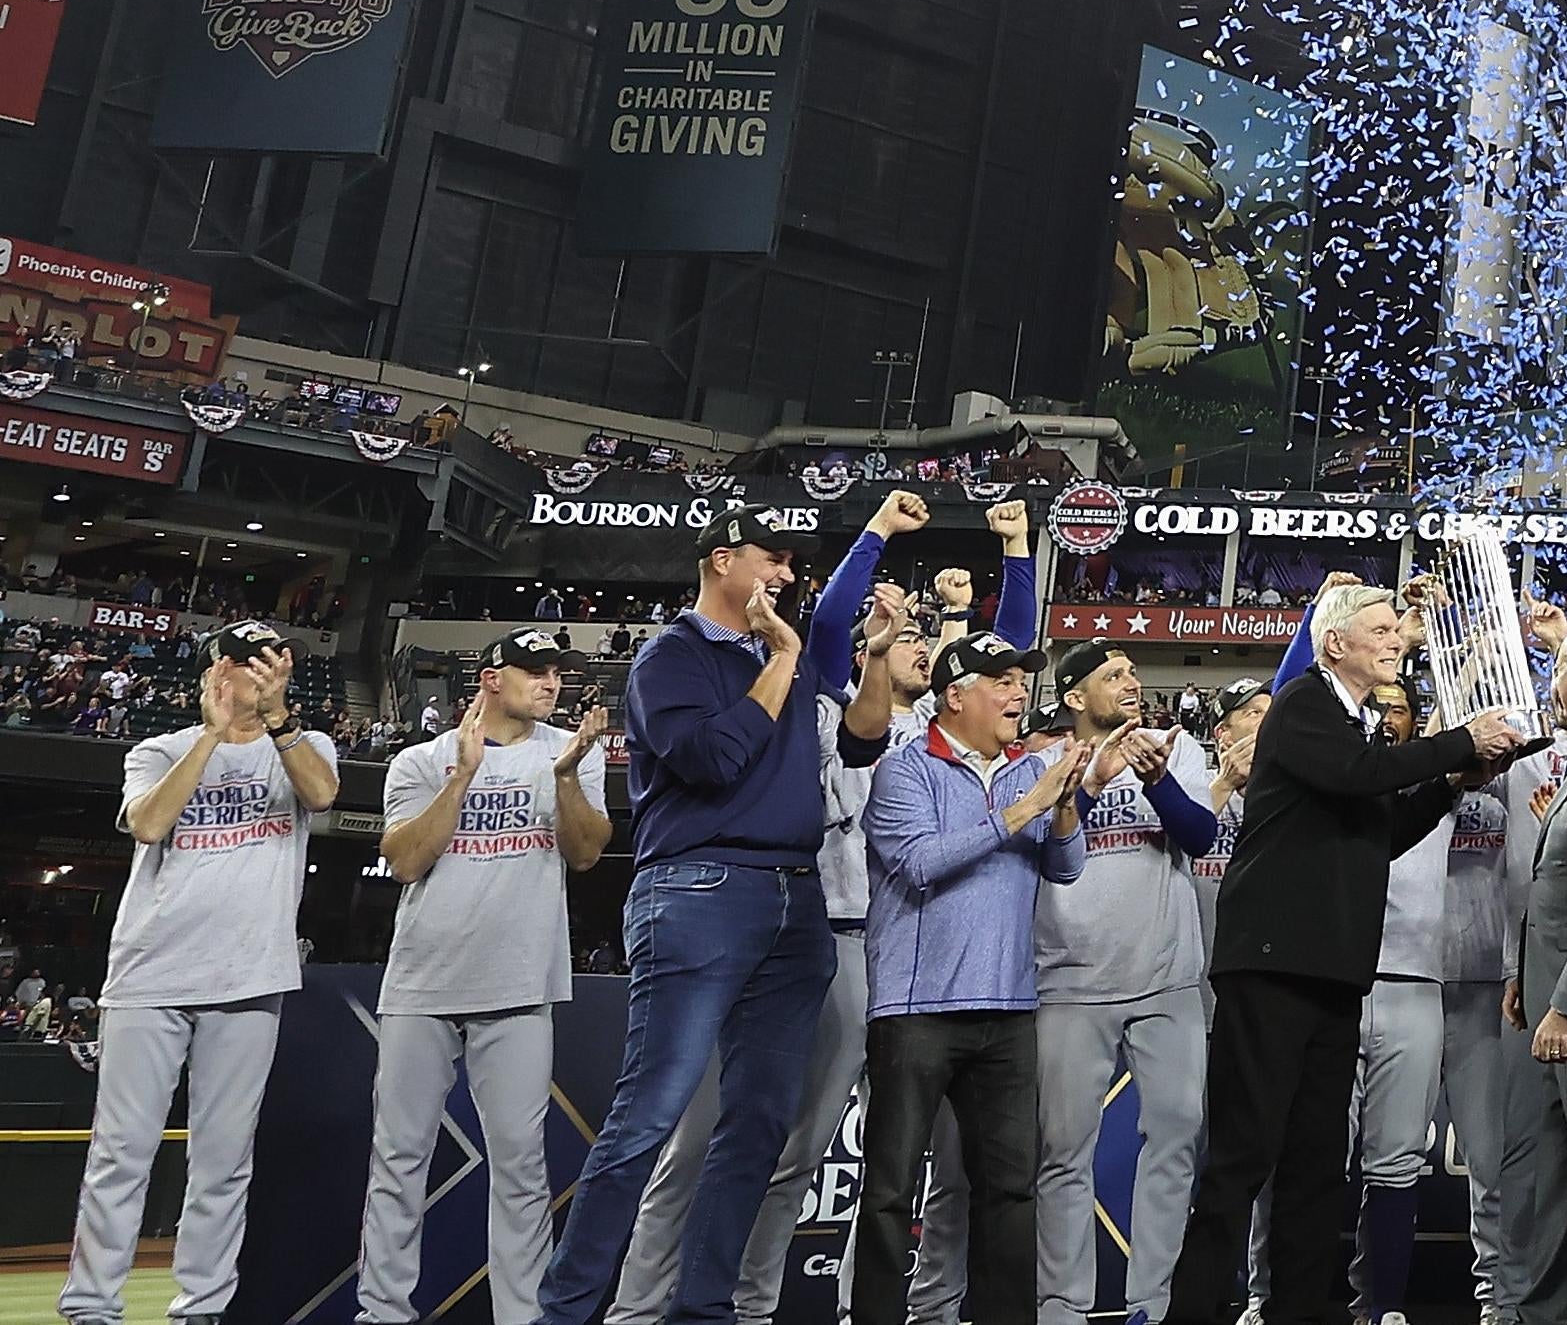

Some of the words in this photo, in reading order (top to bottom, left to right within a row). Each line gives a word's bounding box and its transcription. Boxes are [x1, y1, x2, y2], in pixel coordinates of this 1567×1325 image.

[214, 5, 284, 44] Give
[275, 9, 368, 49] Back
[627, 20, 785, 58] MILLION
[685, 60, 713, 83] IN
[617, 86, 773, 113] CHARITABLE
[609, 114, 767, 157] GIVING
[18, 254, 86, 281] Phoenix
[53, 427, 128, 462] SEATS
[142, 439, 173, 455] BAR
[144, 451, 164, 472] S
[529, 492, 679, 527] BOURBON
[685, 498, 714, 528] &
[1058, 508, 1081, 516] COLD
[1083, 509, 1112, 517] BEERS
[1134, 505, 1239, 535] COLD
[1248, 507, 1374, 541] BEERS
[1385, 508, 1411, 543] &
[94, 606, 171, 632] BAR-S
[1168, 610, 1215, 639] Your
[462, 789, 532, 811] ORLD
[1098, 787, 1137, 809] RLD
[179, 801, 267, 827] SERIES
[459, 809, 529, 831] ERIES
[1084, 806, 1138, 831] RIES
[175, 818, 292, 851] CHAMPIONS
[446, 833, 555, 855] HAMPIONS
